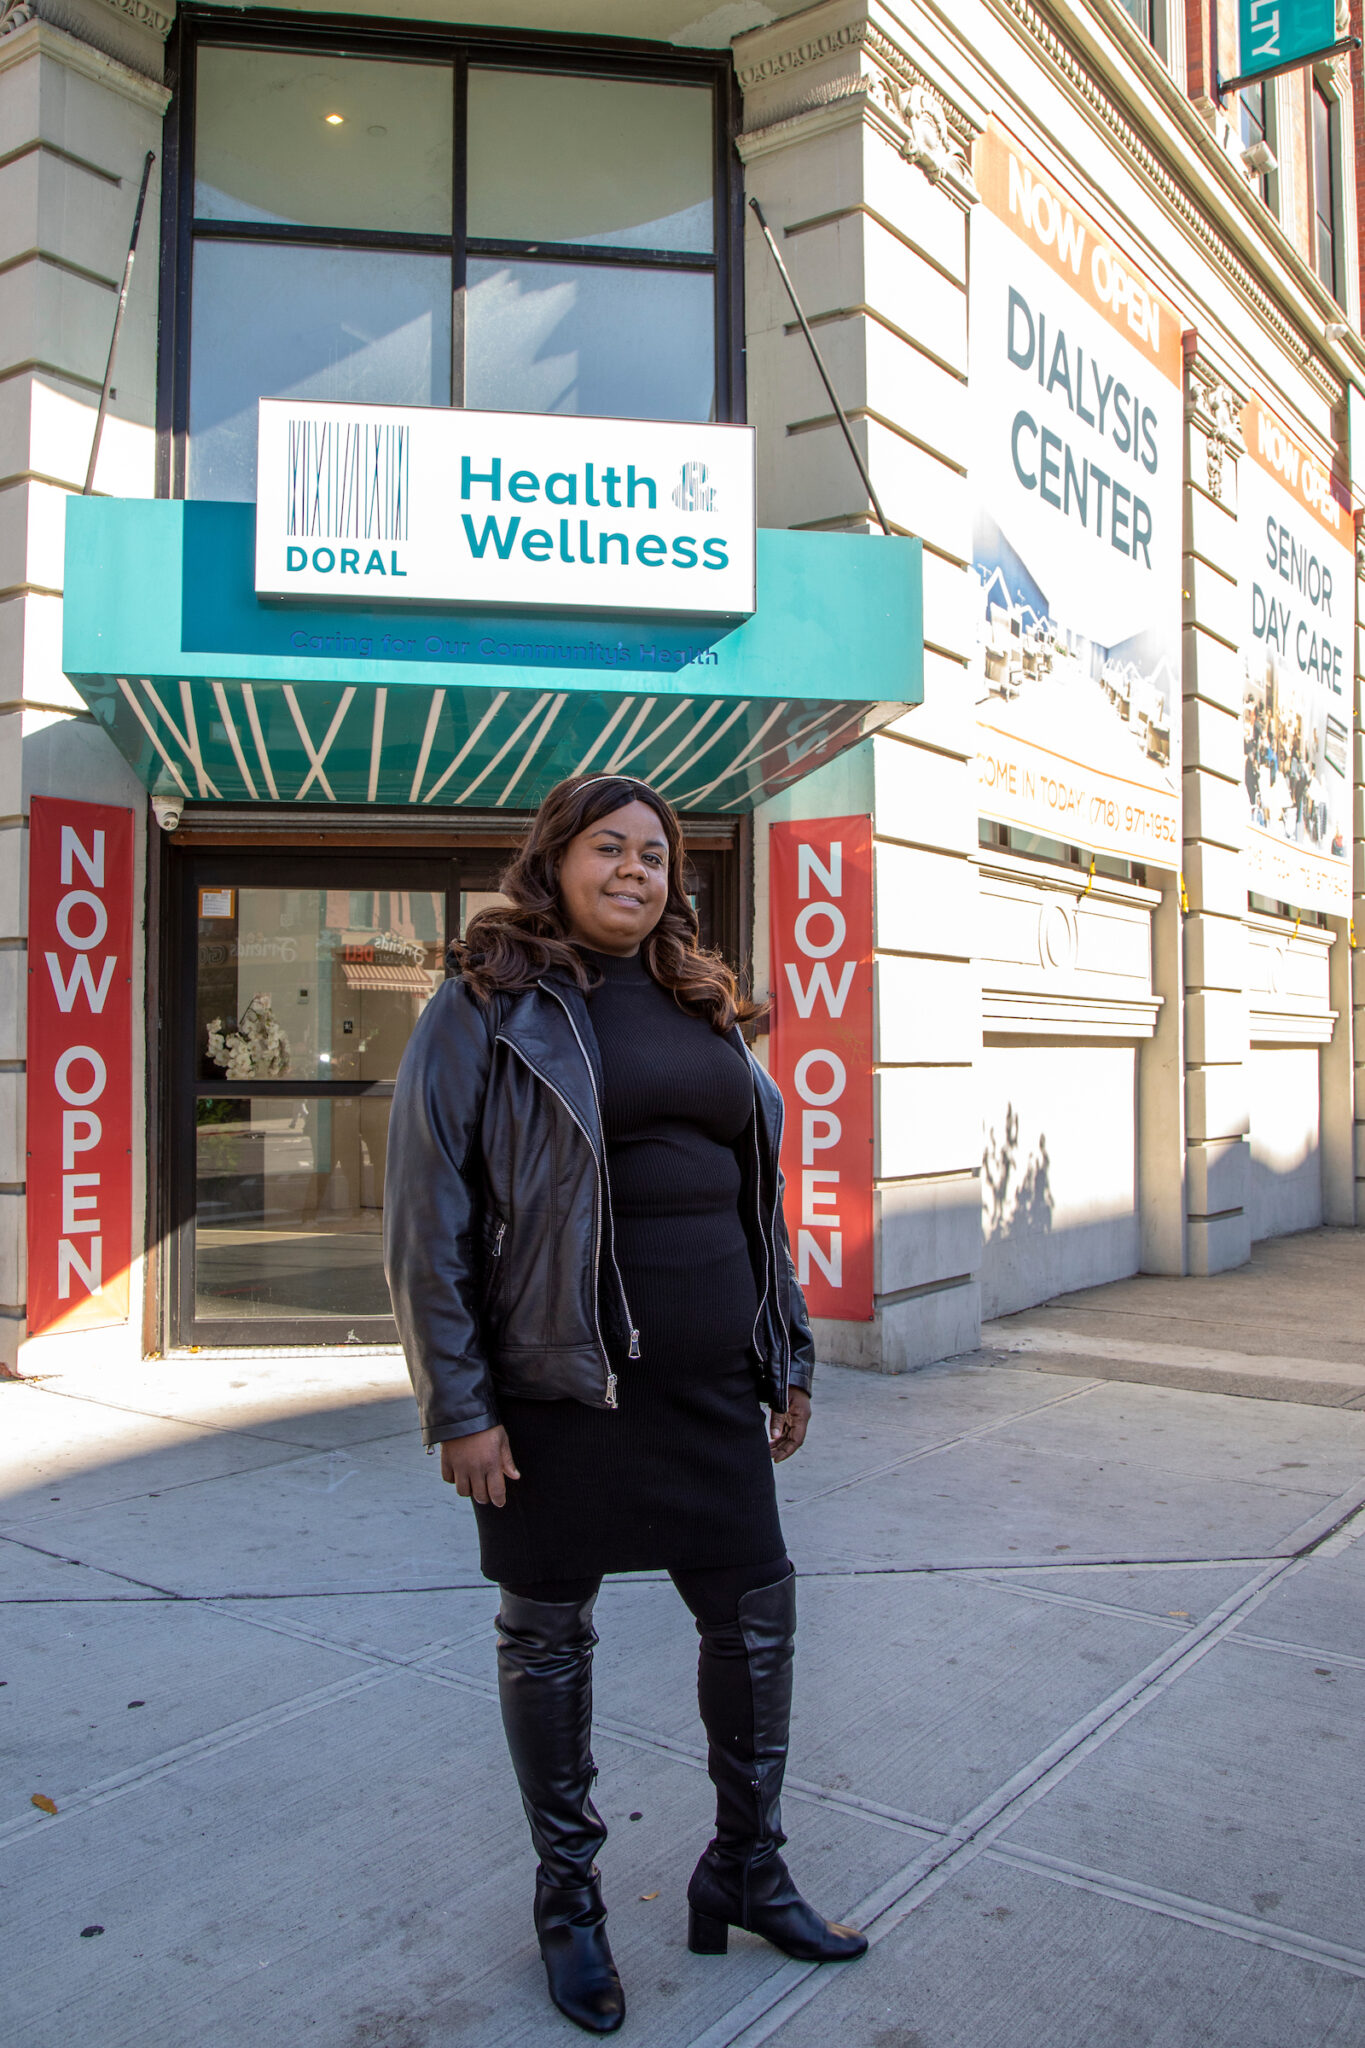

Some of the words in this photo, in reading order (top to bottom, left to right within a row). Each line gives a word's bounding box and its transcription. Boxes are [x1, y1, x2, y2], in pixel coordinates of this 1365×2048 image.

[1009, 153, 1085, 275] NOW
[1091, 245, 1160, 353] OPEN
[1007, 285, 1158, 475] DIALYSIS
[461, 455, 656, 509] Health
[671, 461, 718, 512] &
[1011, 410, 1152, 570] CENTER
[1258, 410, 1299, 487] NOW
[1301, 460, 1340, 530] OPEN
[286, 546, 408, 577] DORAL
[461, 514, 729, 570] Wellness
[1266, 515, 1333, 618] SENIOR
[290, 630, 373, 656] Caring
[382, 634, 416, 653] for
[425, 635, 471, 654] Our
[478, 638, 631, 666] Community's
[639, 644, 719, 666] Health
[1253, 582, 1291, 657] DAY
[1296, 620, 1343, 697] CARE
[1022, 770, 1036, 801] IN
[1125, 806, 1176, 843] 971-1952
[44, 825, 117, 1014] NOW
[784, 841, 857, 1018] NOW
[54, 1045, 108, 1300] OPEN
[794, 1049, 847, 1288] OPEN
